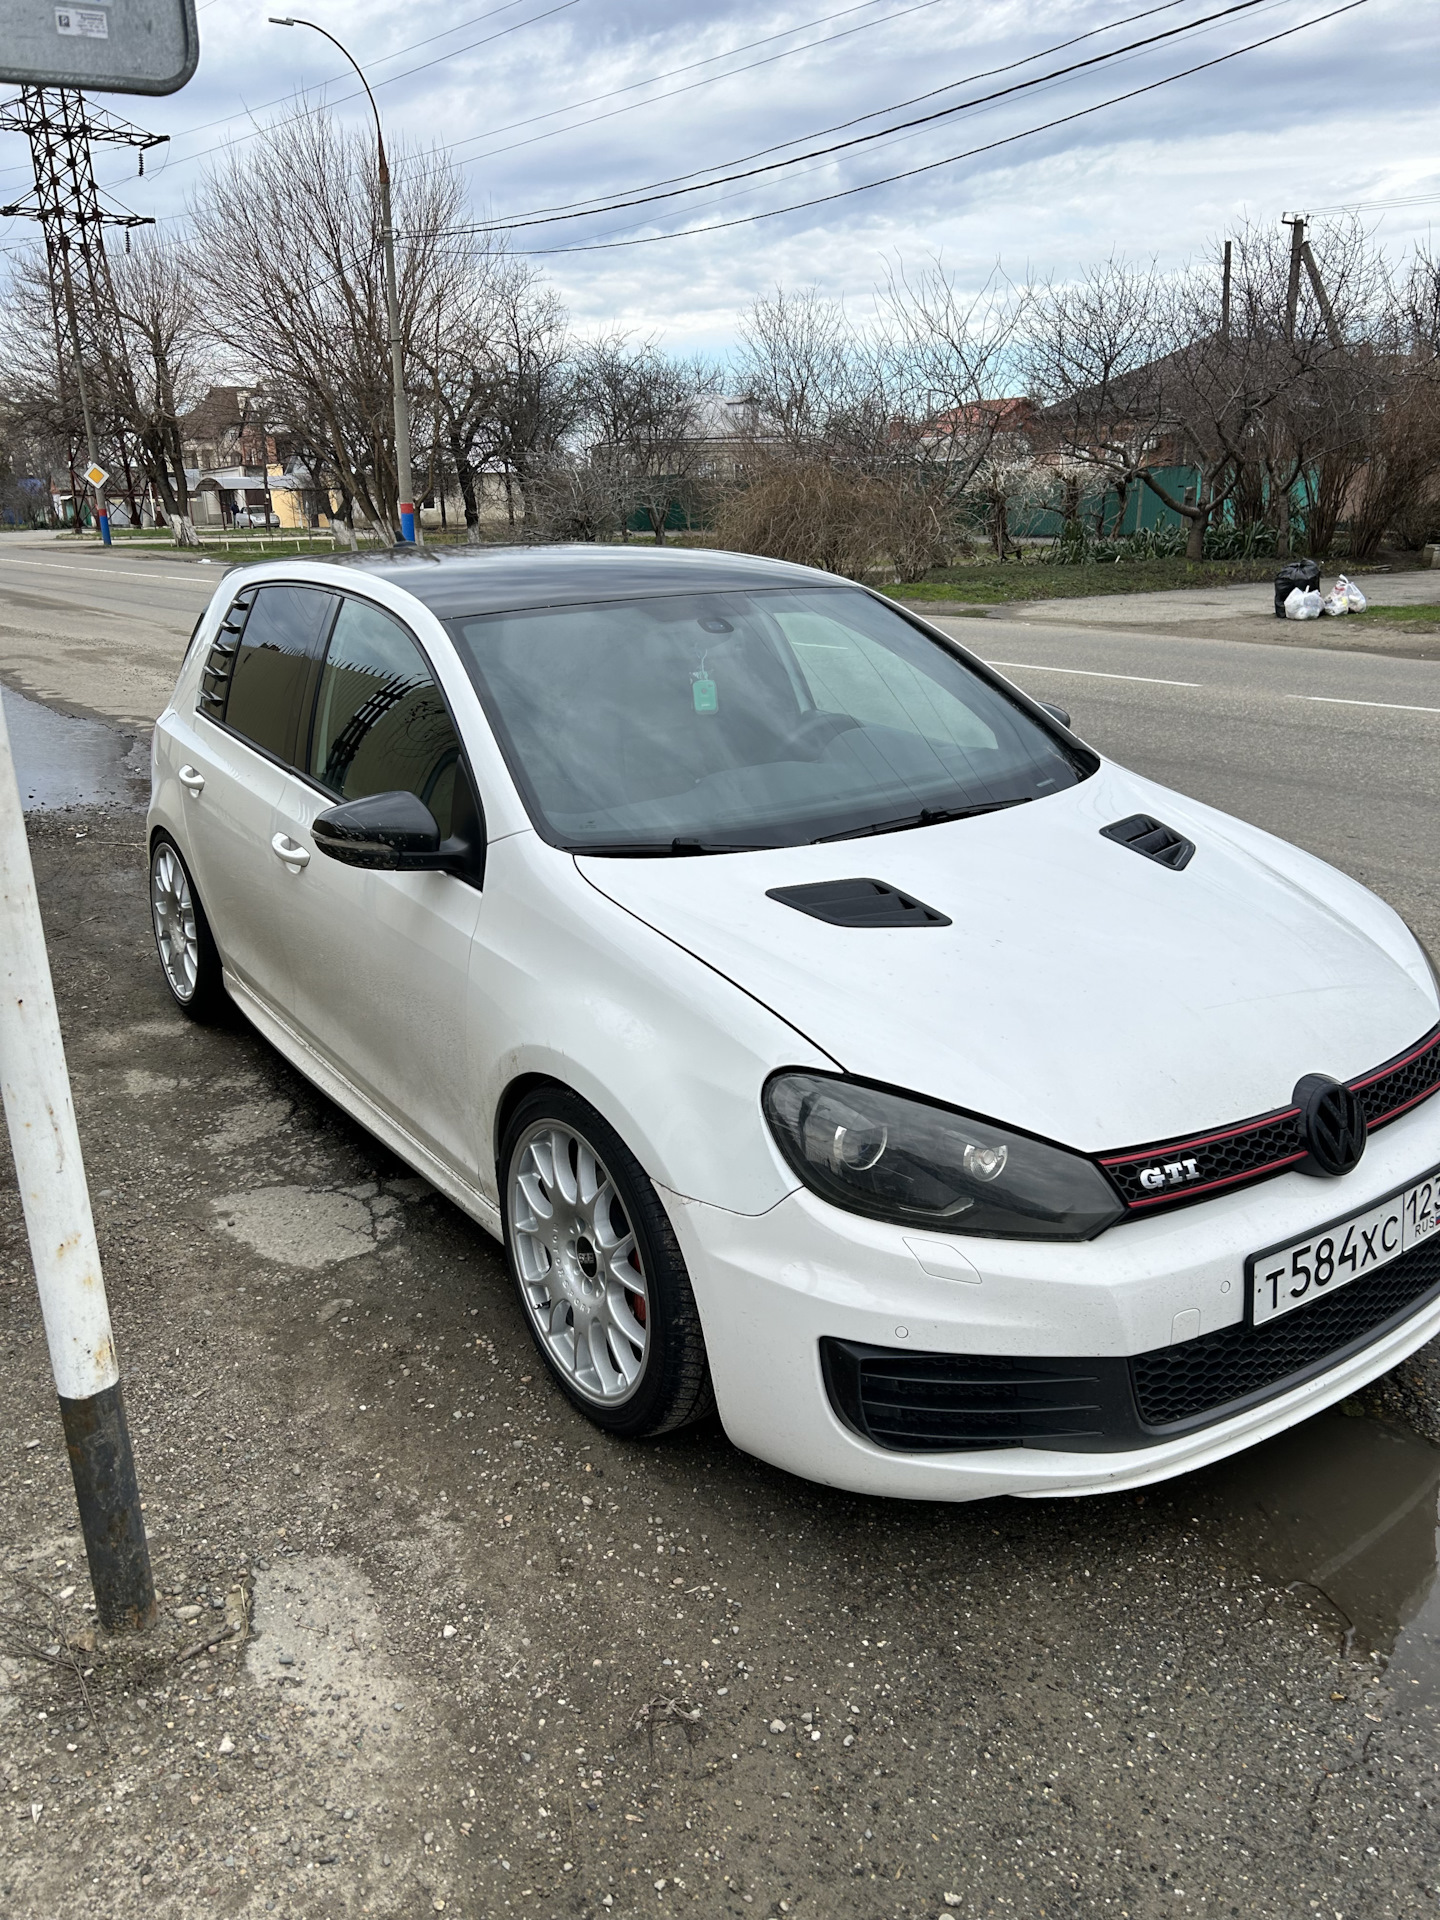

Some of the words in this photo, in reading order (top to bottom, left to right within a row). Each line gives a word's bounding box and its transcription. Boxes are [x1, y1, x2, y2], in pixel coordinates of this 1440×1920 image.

[1140, 1158, 1200, 1190] GTI
[1415, 1215, 1435, 1238] RUS
[1265, 1215, 1398, 1309] Т584ХС
